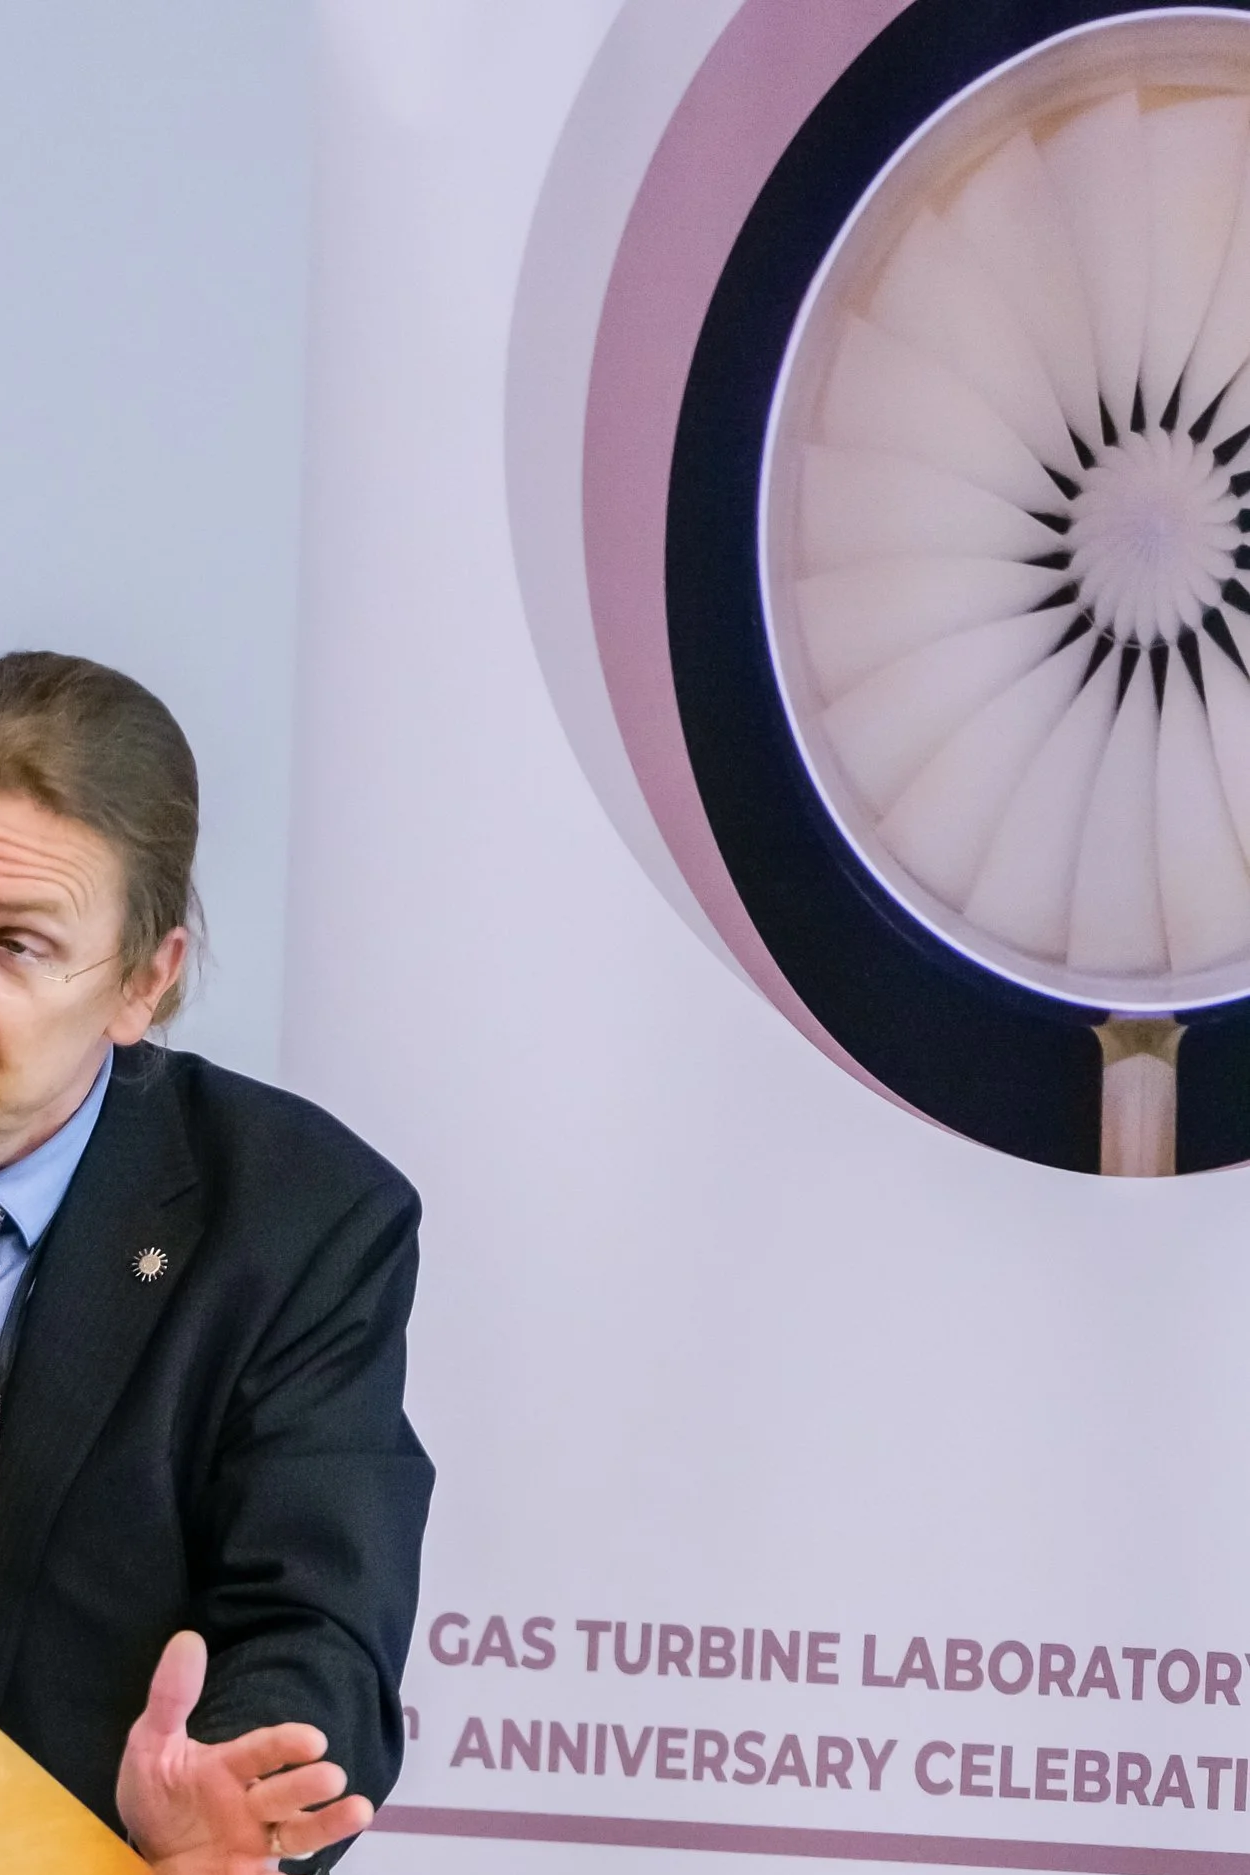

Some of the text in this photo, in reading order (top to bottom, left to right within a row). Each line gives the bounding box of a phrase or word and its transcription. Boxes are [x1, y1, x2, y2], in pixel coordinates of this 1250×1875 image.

[427, 1611, 1250, 1707] GAS TURBINE LABORATOR
[448, 1715, 899, 1792] ANNIVERSARY
